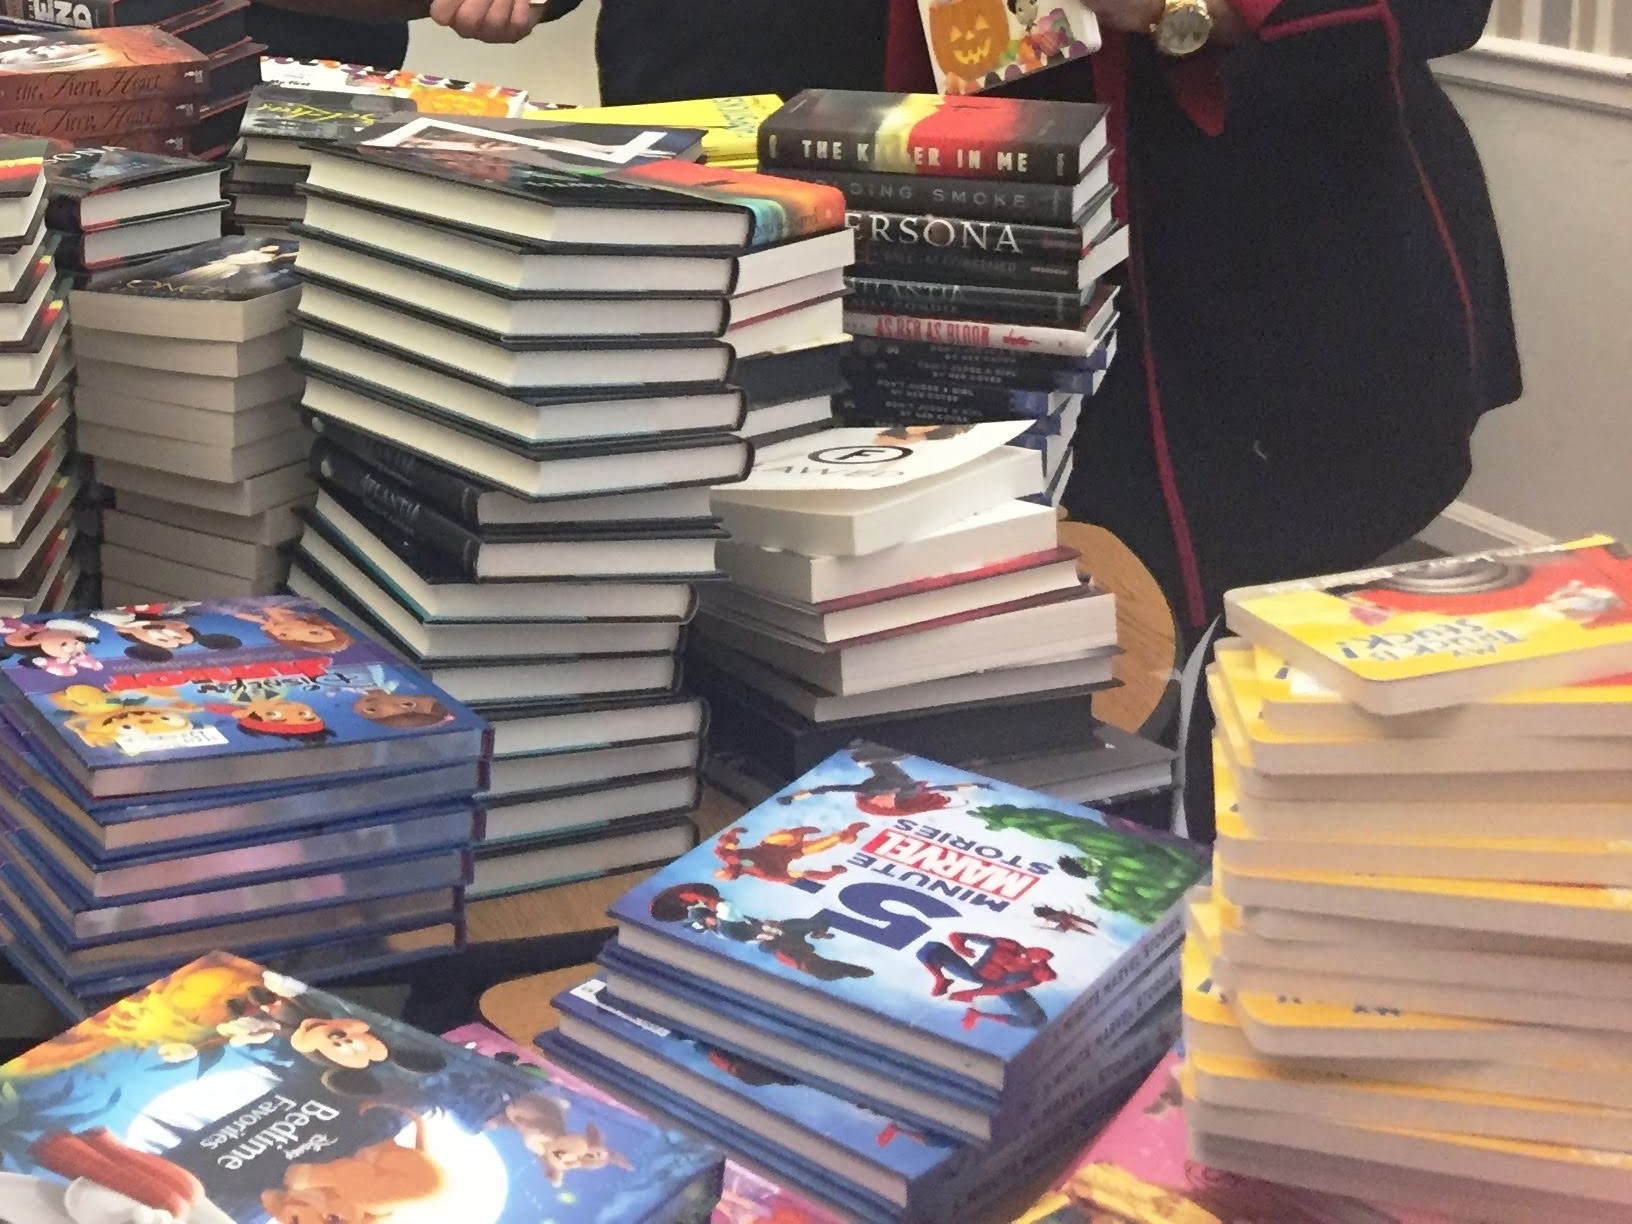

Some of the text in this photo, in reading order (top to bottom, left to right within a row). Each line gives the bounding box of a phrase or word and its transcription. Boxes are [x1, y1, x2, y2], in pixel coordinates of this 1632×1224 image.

[802, 139, 842, 161] THE
[957, 149, 981, 169] IN
[997, 151, 1028, 172] ME
[932, 188, 1026, 208] SMOKE
[844, 212, 1024, 255] ERSONA
[868, 829, 1038, 900] MARVEL
[895, 819, 1055, 876] STORIES
[847, 852, 1010, 913] MINUTE
[200, 1094, 297, 1150] Favorites
[217, 1099, 340, 1170] Bedtime
